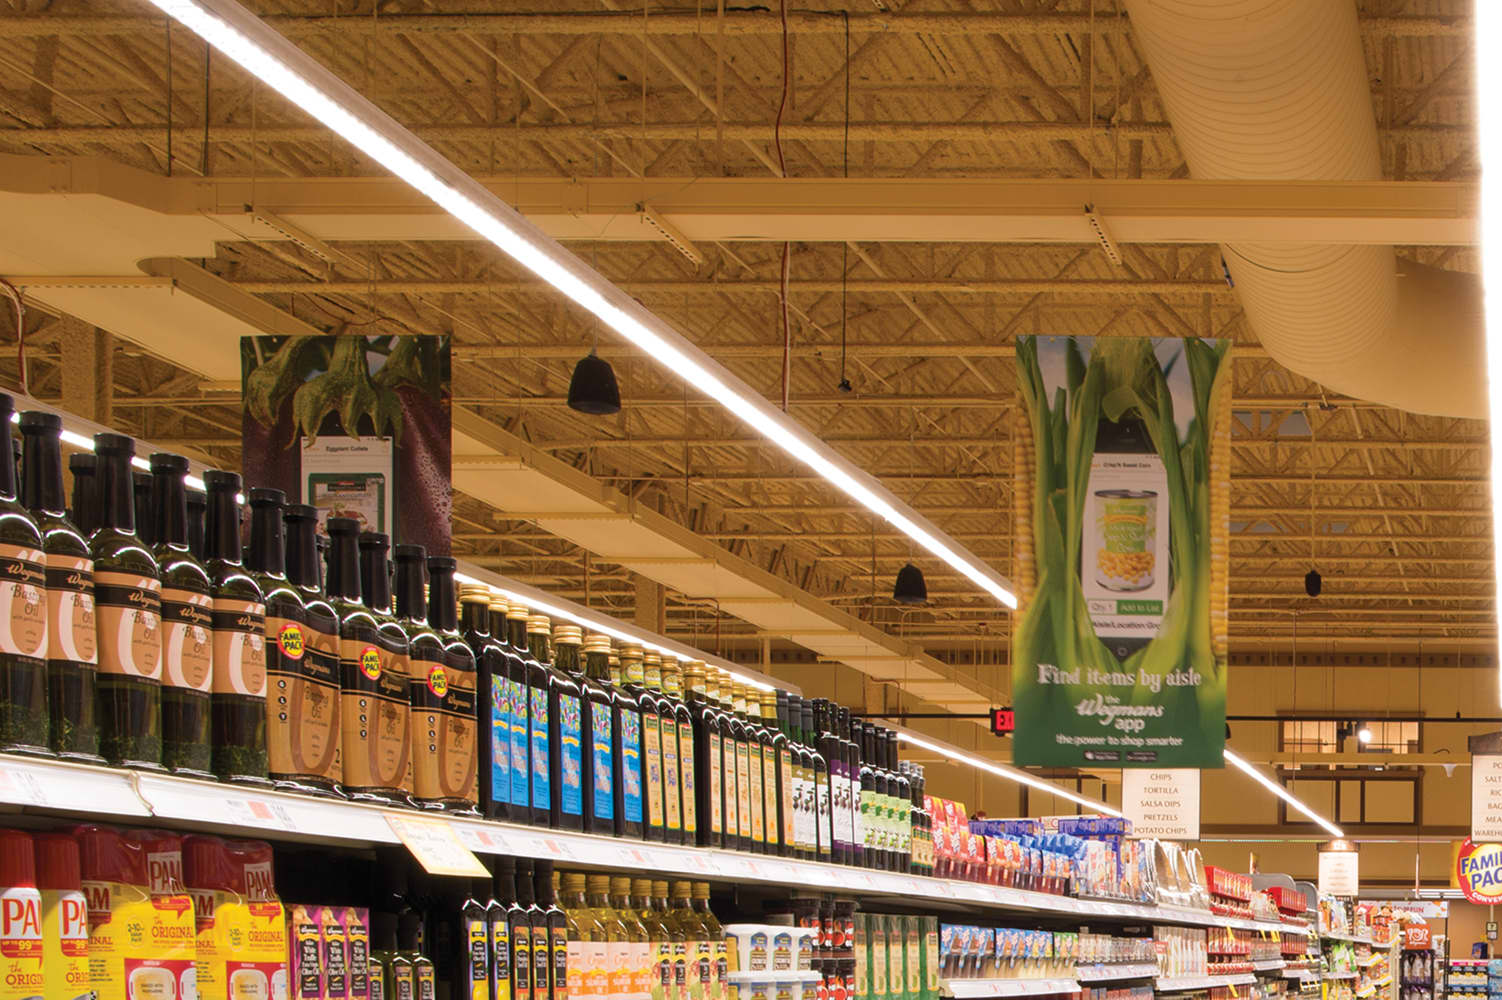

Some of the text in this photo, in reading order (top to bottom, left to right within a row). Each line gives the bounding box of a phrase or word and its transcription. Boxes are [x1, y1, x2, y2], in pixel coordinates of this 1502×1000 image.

[1037, 664, 1202, 693] Find items by aisle
[1105, 696, 1120, 705] the
[1074, 693, 1164, 725] Wegmans
[1114, 718, 1145, 733] app
[1056, 734, 1183, 747] the power to shop smarter
[1150, 773, 1172, 781] CHIPS
[3, 898, 42, 936] PA
